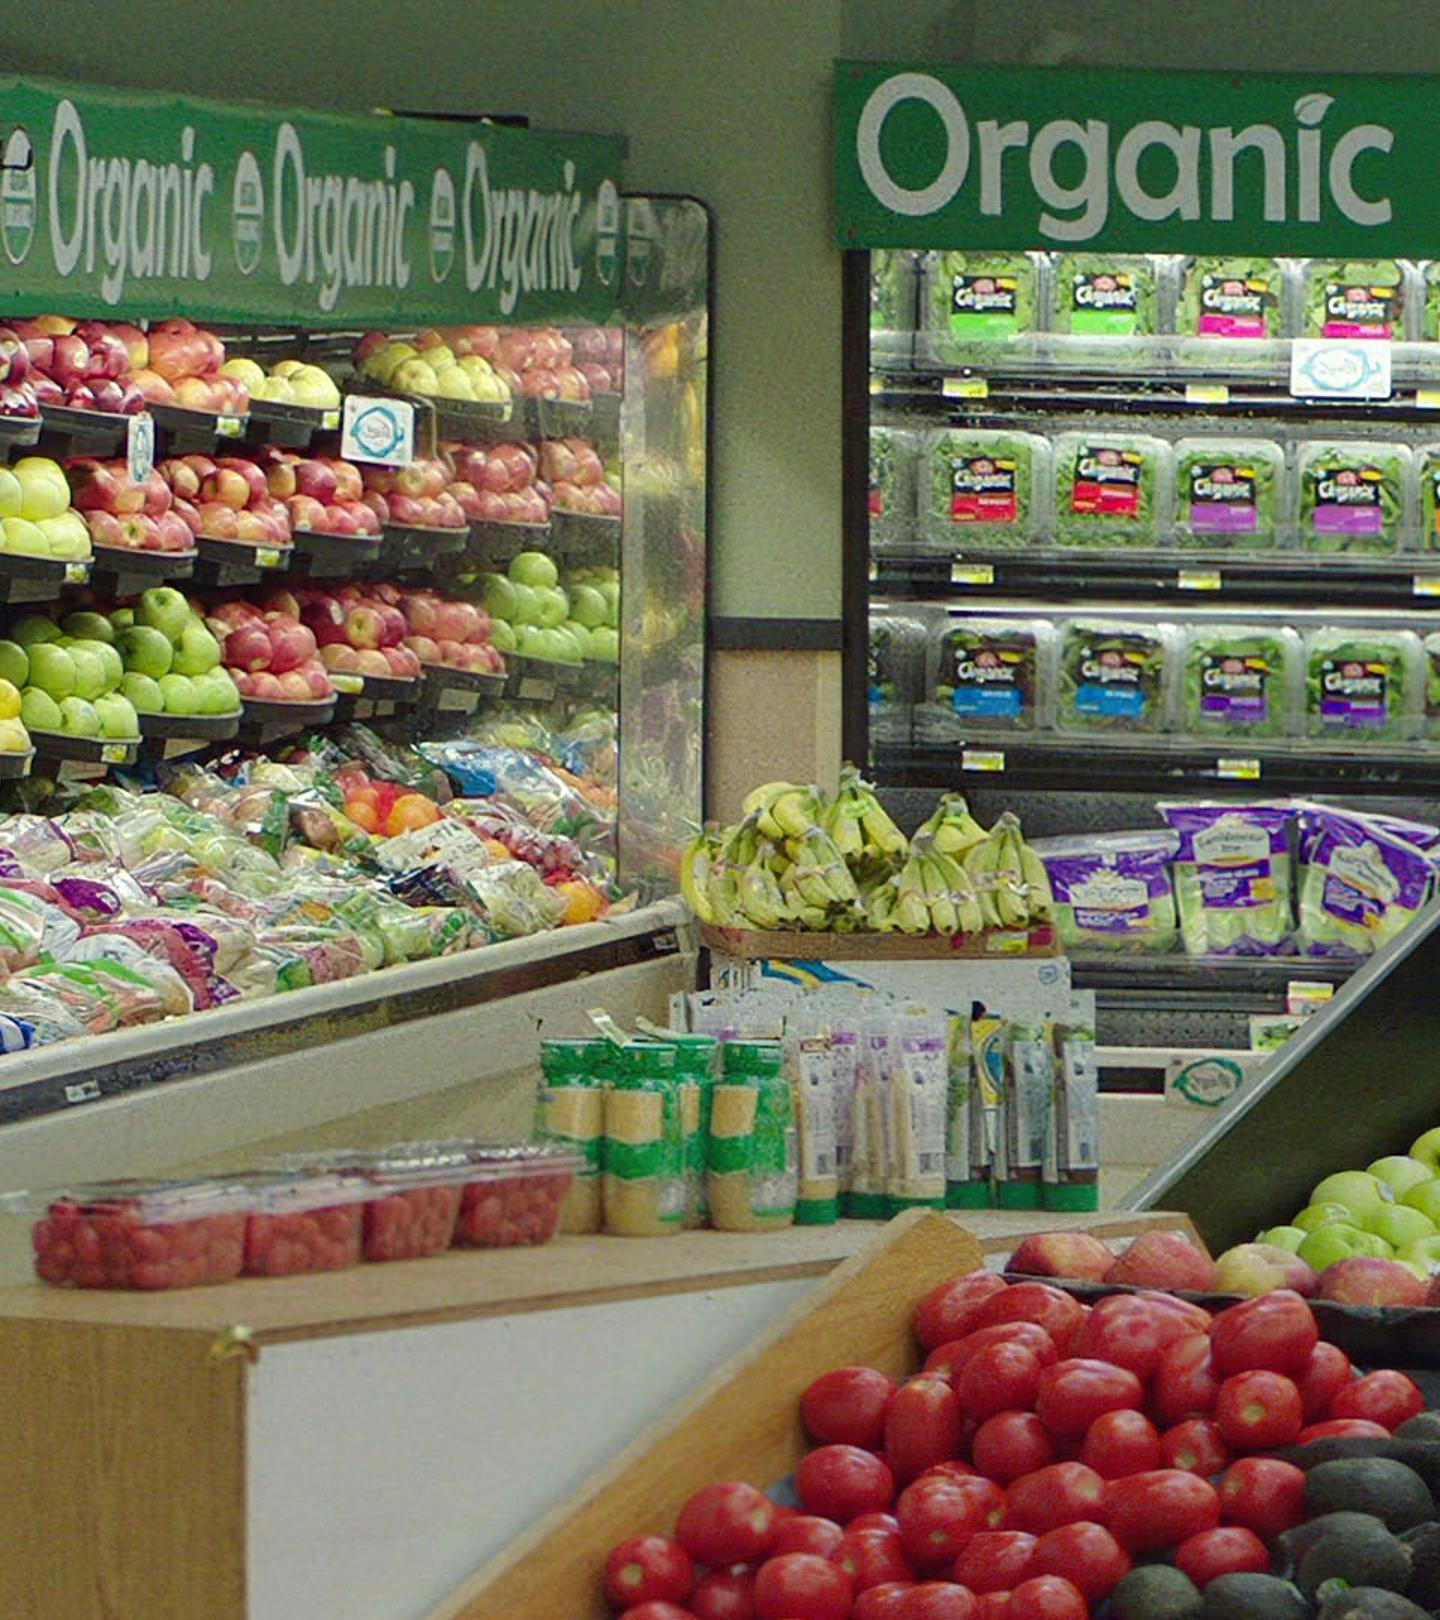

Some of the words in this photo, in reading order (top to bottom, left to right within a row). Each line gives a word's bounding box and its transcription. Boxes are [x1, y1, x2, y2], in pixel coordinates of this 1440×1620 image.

[50, 99, 214, 305] Organic
[274, 122, 414, 311] Organic
[463, 141, 581, 315] Organic
[857, 73, 1393, 242] Organic
